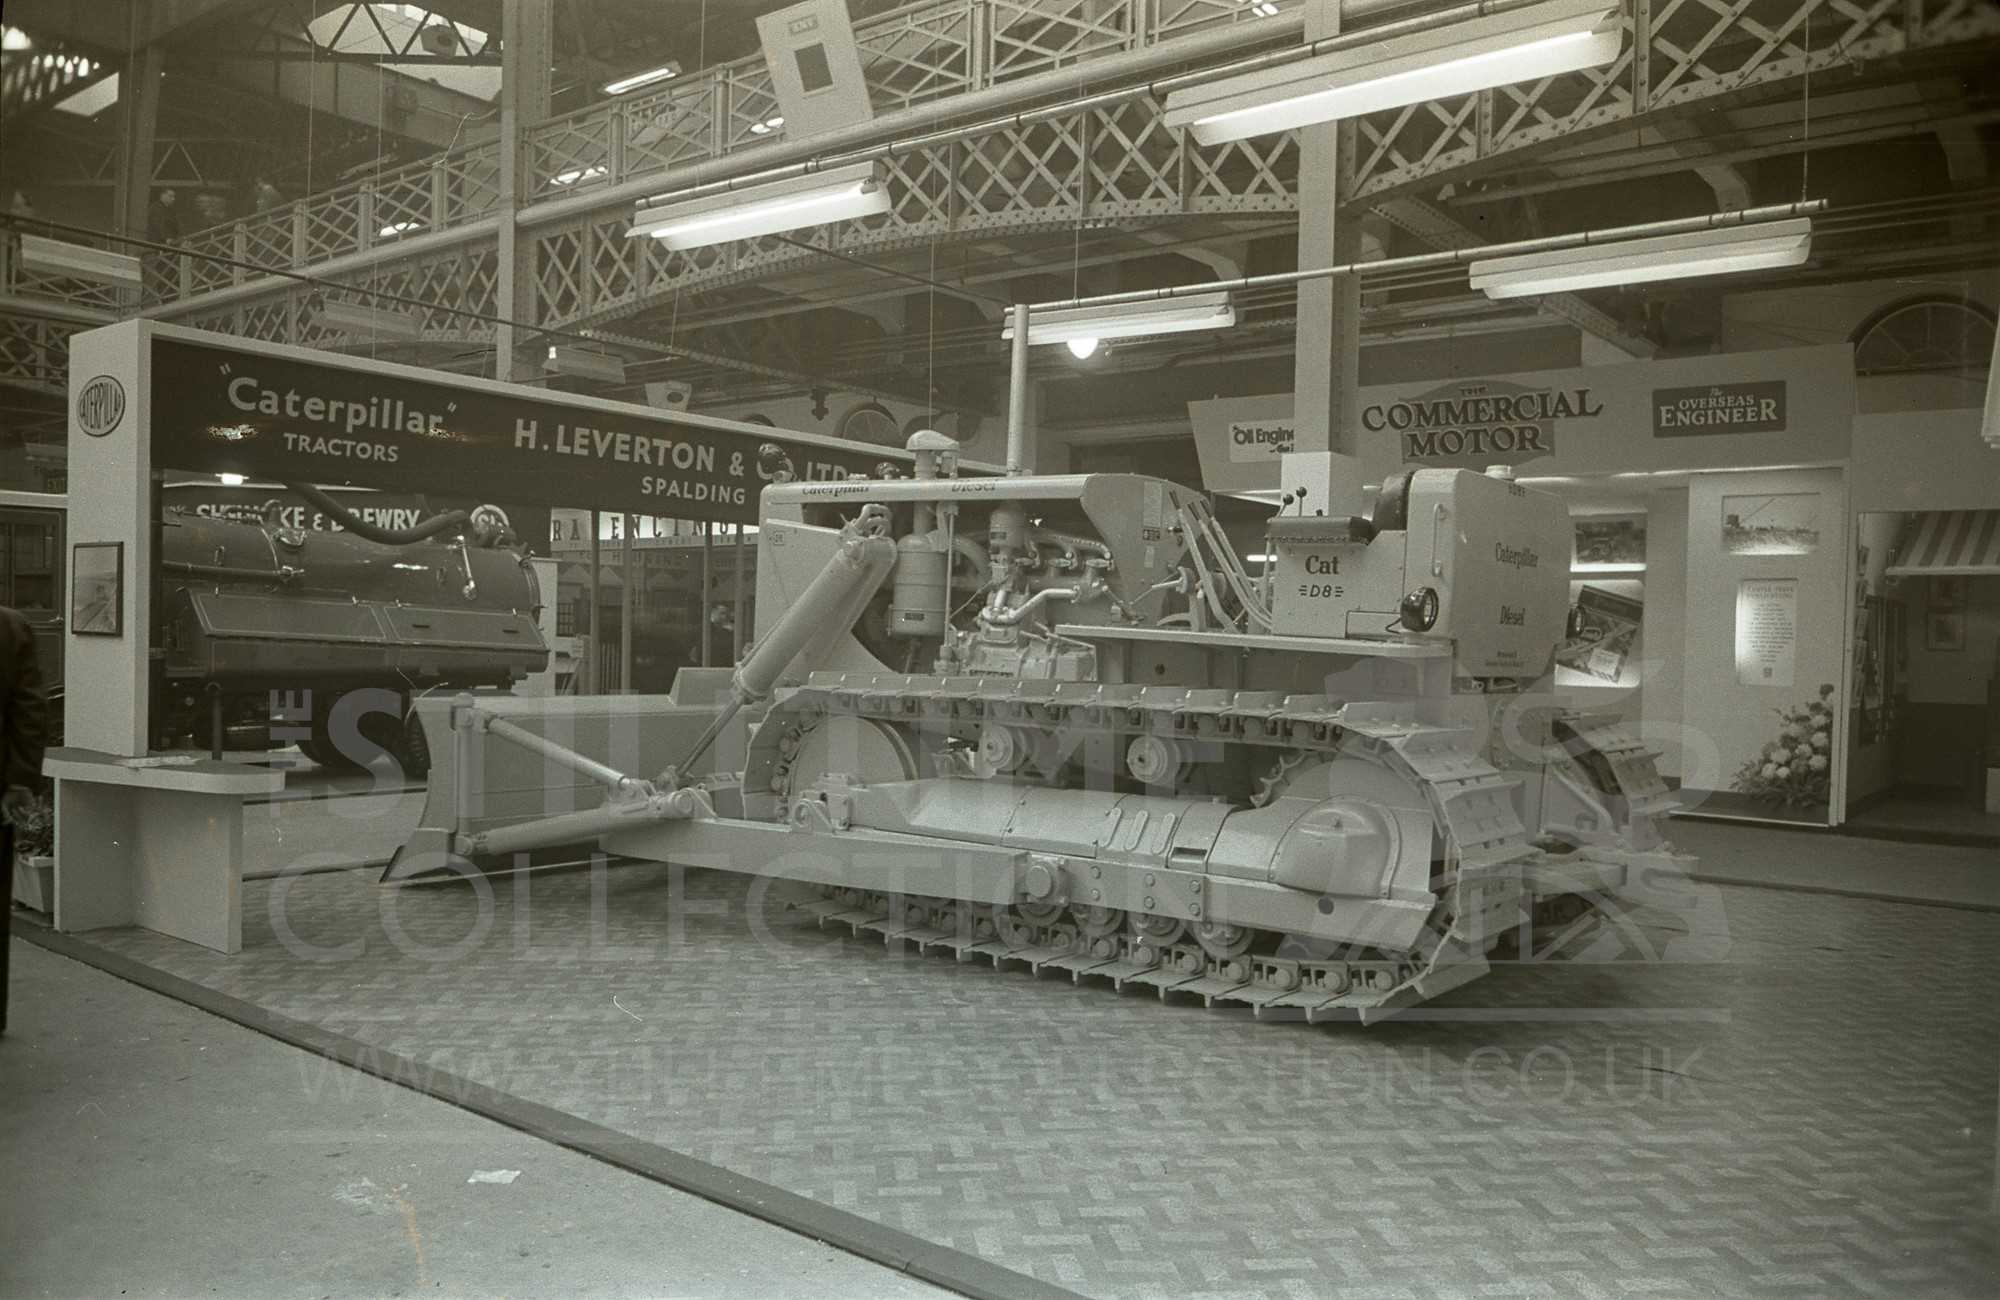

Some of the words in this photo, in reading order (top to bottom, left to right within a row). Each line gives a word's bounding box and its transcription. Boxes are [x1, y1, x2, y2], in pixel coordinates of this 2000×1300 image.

[1361, 389, 1604, 431] COMMERCIAL
[1659, 399, 1778, 427] ENGINEER
[1679, 395, 1754, 410] OVERSEAS
[284, 432, 399, 462] TRACTORS
[1407, 425, 1549, 458] MOTOR
[729, 451, 745, 477] &
[641, 476, 746, 505] SPALDING
[1305, 555, 1340, 575] Cat
[1310, 584, 1332, 598] D8
